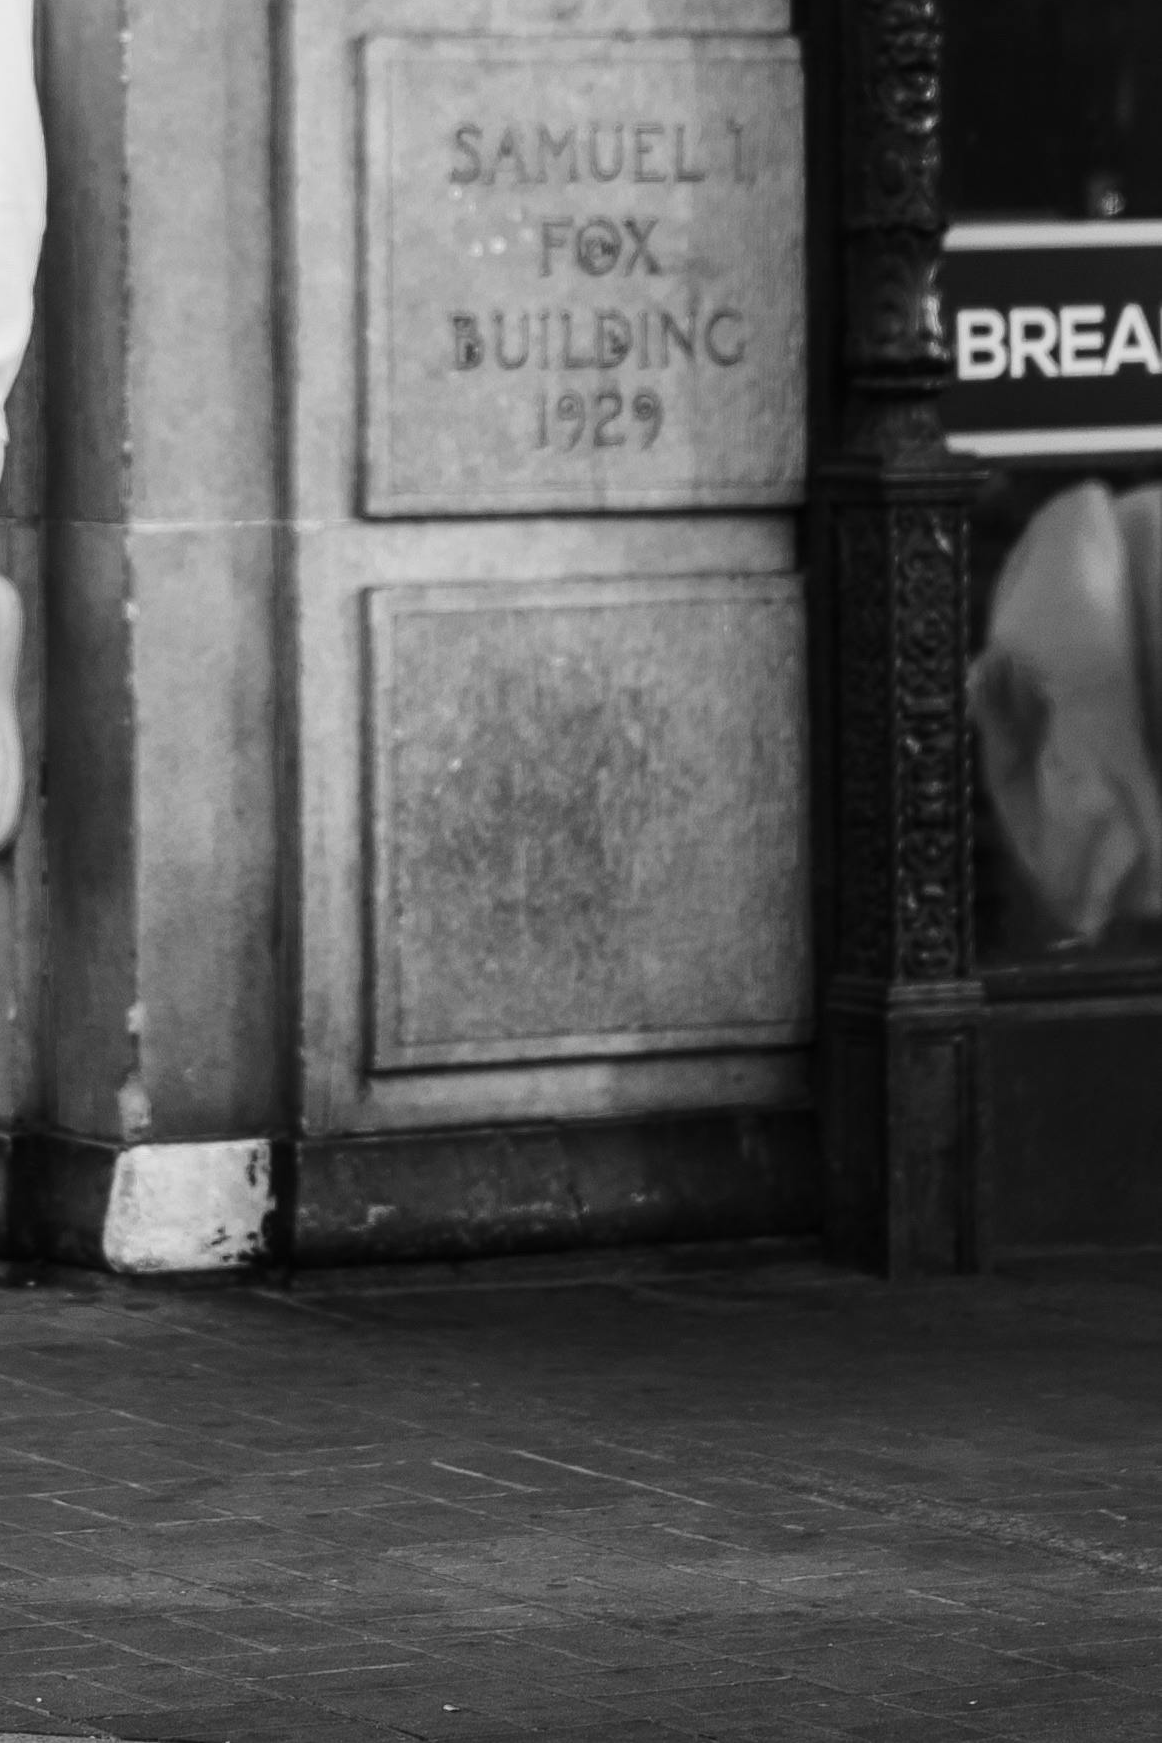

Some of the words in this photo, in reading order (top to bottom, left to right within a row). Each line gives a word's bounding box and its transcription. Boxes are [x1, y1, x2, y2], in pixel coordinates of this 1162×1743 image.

[448, 120, 706, 186] SAMUEL
[539, 214, 664, 278] FOX
[449, 306, 747, 372] BUILDING
[956, 303, 1162, 381] BREA
[536, 386, 666, 453] 1929
